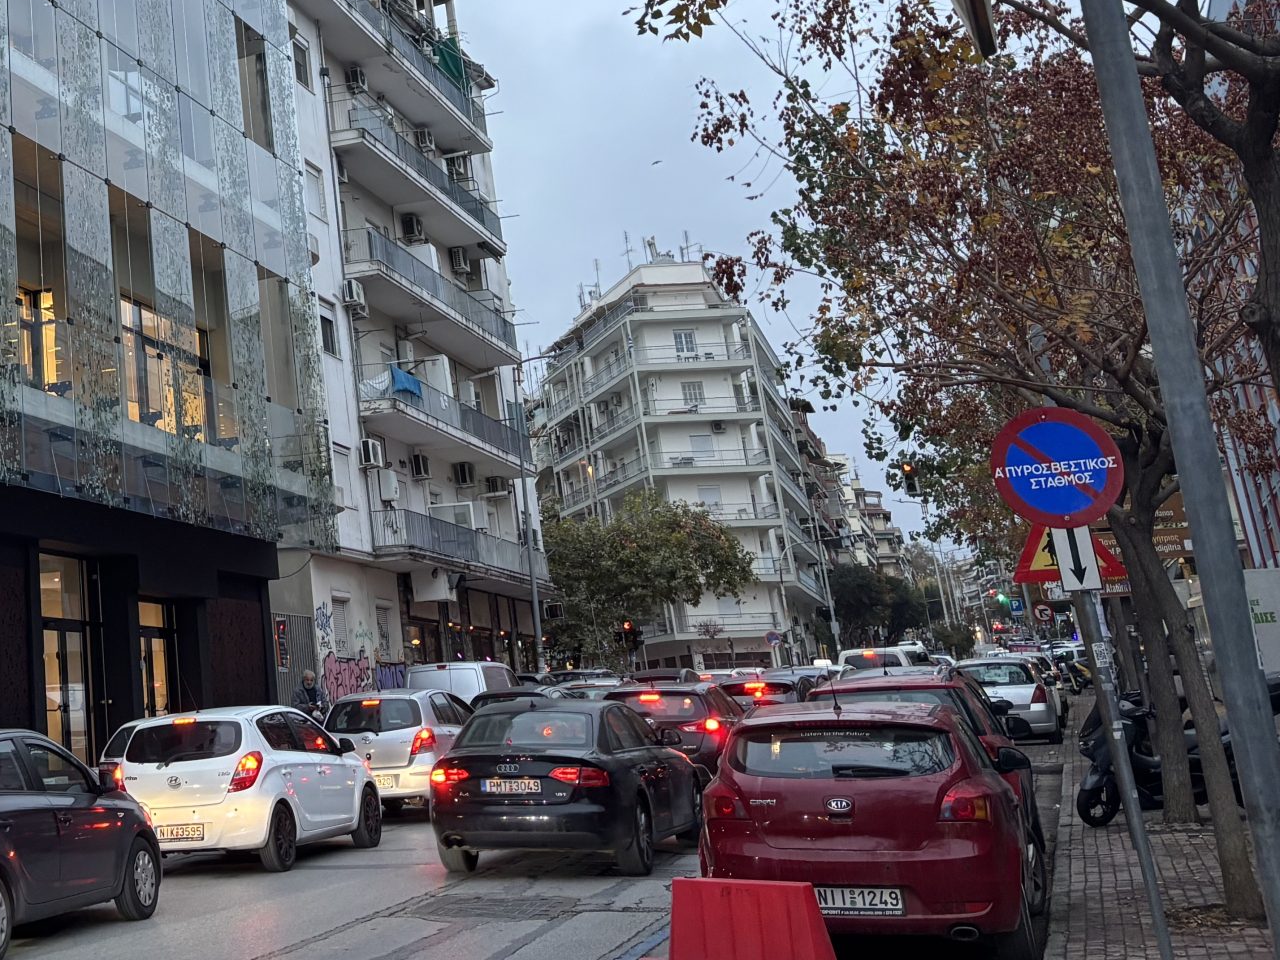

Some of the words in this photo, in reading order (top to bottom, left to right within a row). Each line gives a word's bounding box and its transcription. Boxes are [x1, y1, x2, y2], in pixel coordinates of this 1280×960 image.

[1005, 456, 1118, 478] ΠΥΡΟΣΒΕΣΤΙΚΟΣ
[1030, 472, 1095, 490] ΣΤΑΘΜΟΣ
[831, 800, 847, 809] KIA
